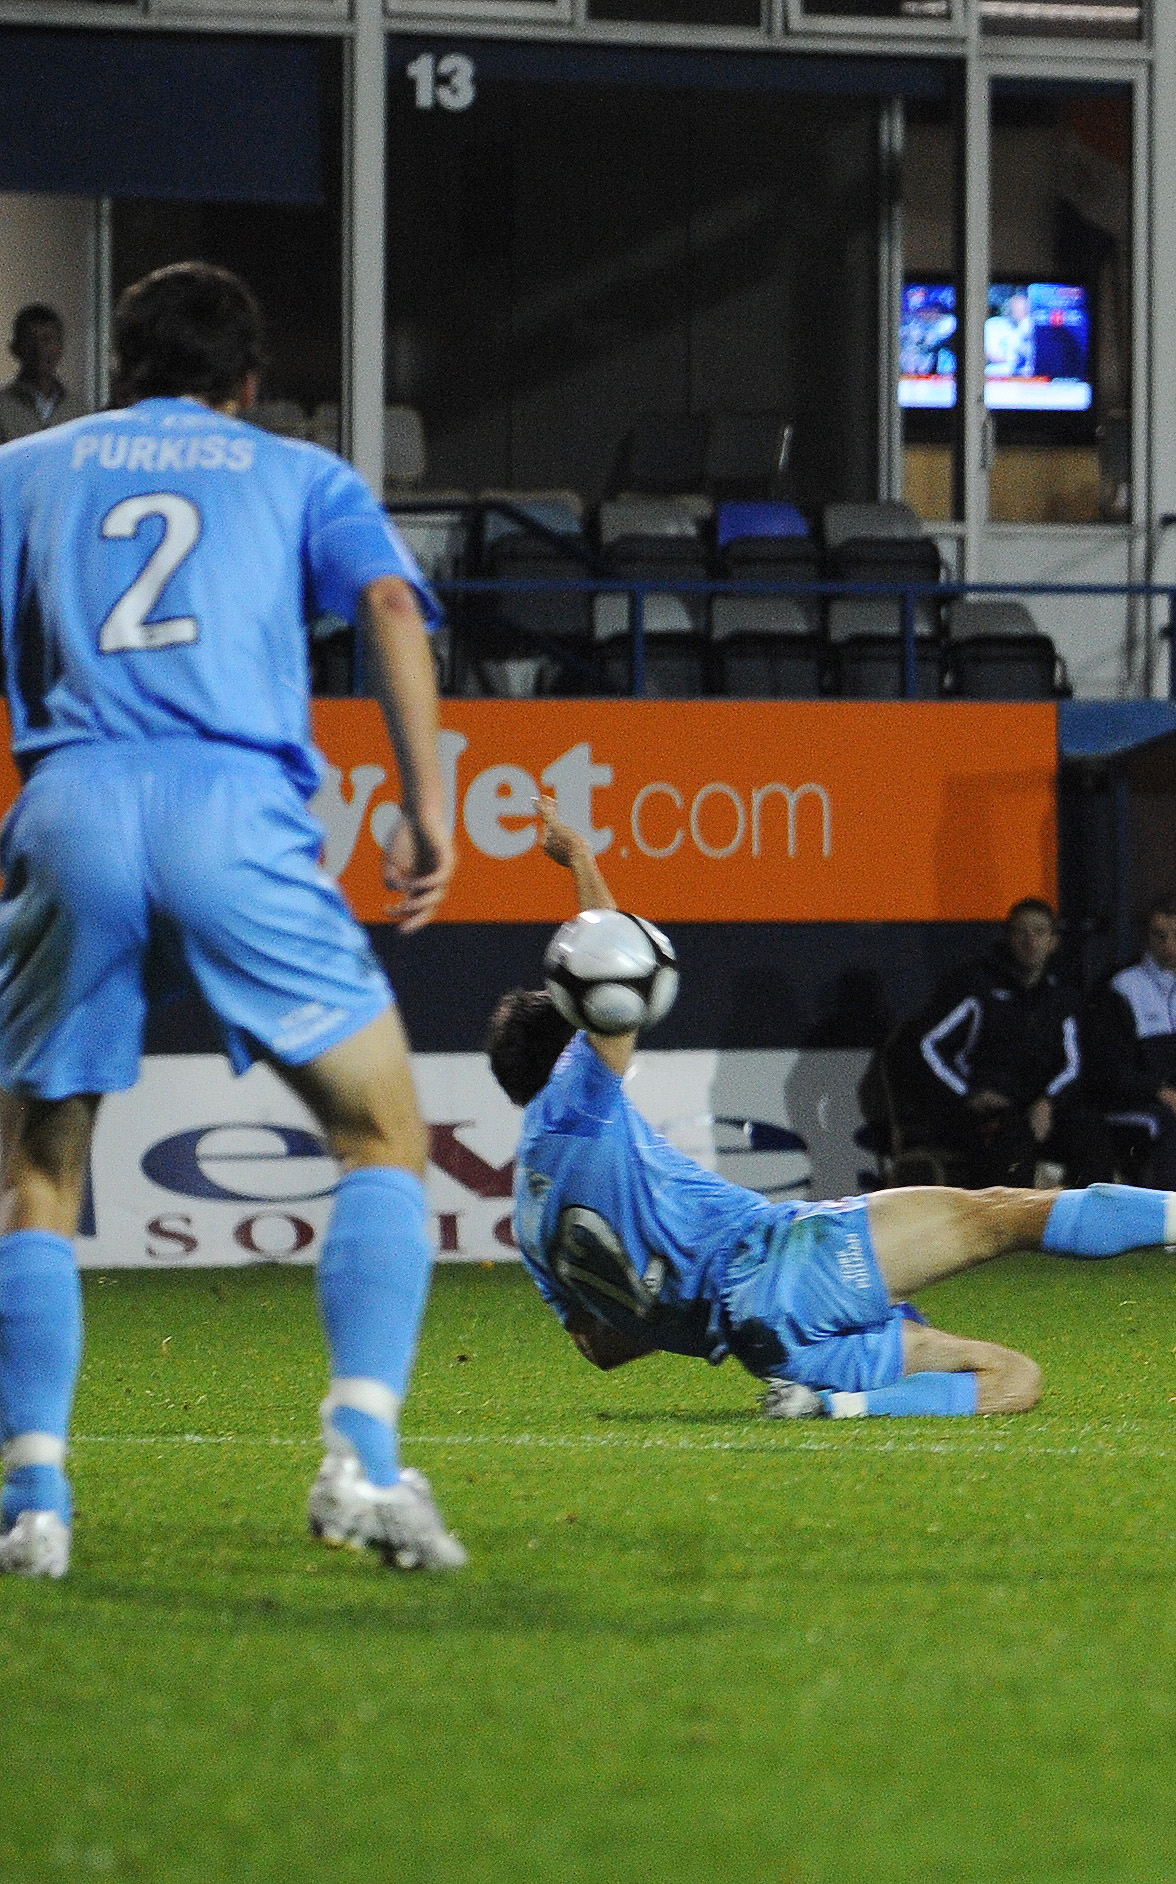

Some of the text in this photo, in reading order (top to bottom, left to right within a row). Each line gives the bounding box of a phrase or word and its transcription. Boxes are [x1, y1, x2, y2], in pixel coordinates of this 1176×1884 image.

[407, 52, 477, 113] 13
[70, 434, 255, 472] PURKISS
[99, 490, 204, 654] 2
